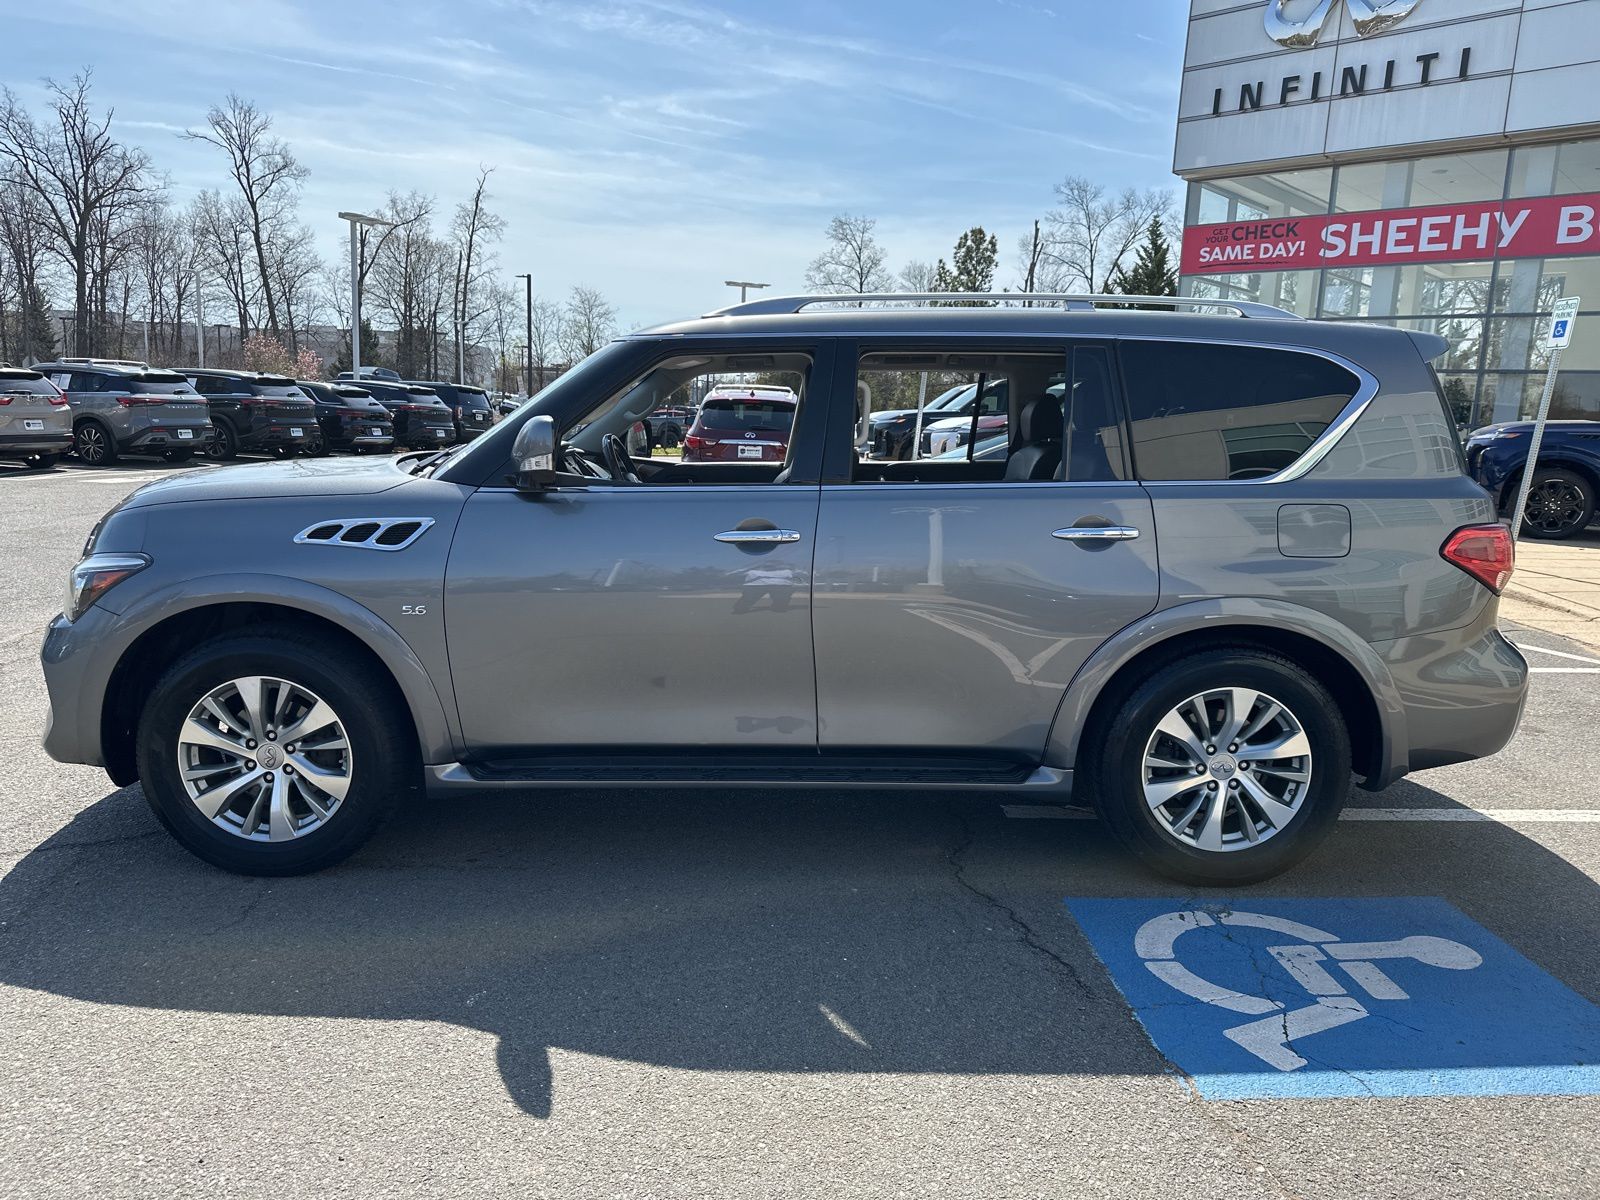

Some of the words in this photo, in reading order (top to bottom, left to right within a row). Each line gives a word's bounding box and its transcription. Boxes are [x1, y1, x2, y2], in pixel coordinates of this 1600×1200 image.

[1212, 47, 1472, 116] INFINITI
[1205, 235, 1229, 244] YOUR
[1212, 228, 1229, 236] GET
[1231, 222, 1299, 241] CHECK
[1318, 209, 1532, 259] SHEEHY
[1556, 205, 1600, 244] B
[1199, 243, 1256, 263] SAME
[1259, 240, 1306, 259] DAY!
